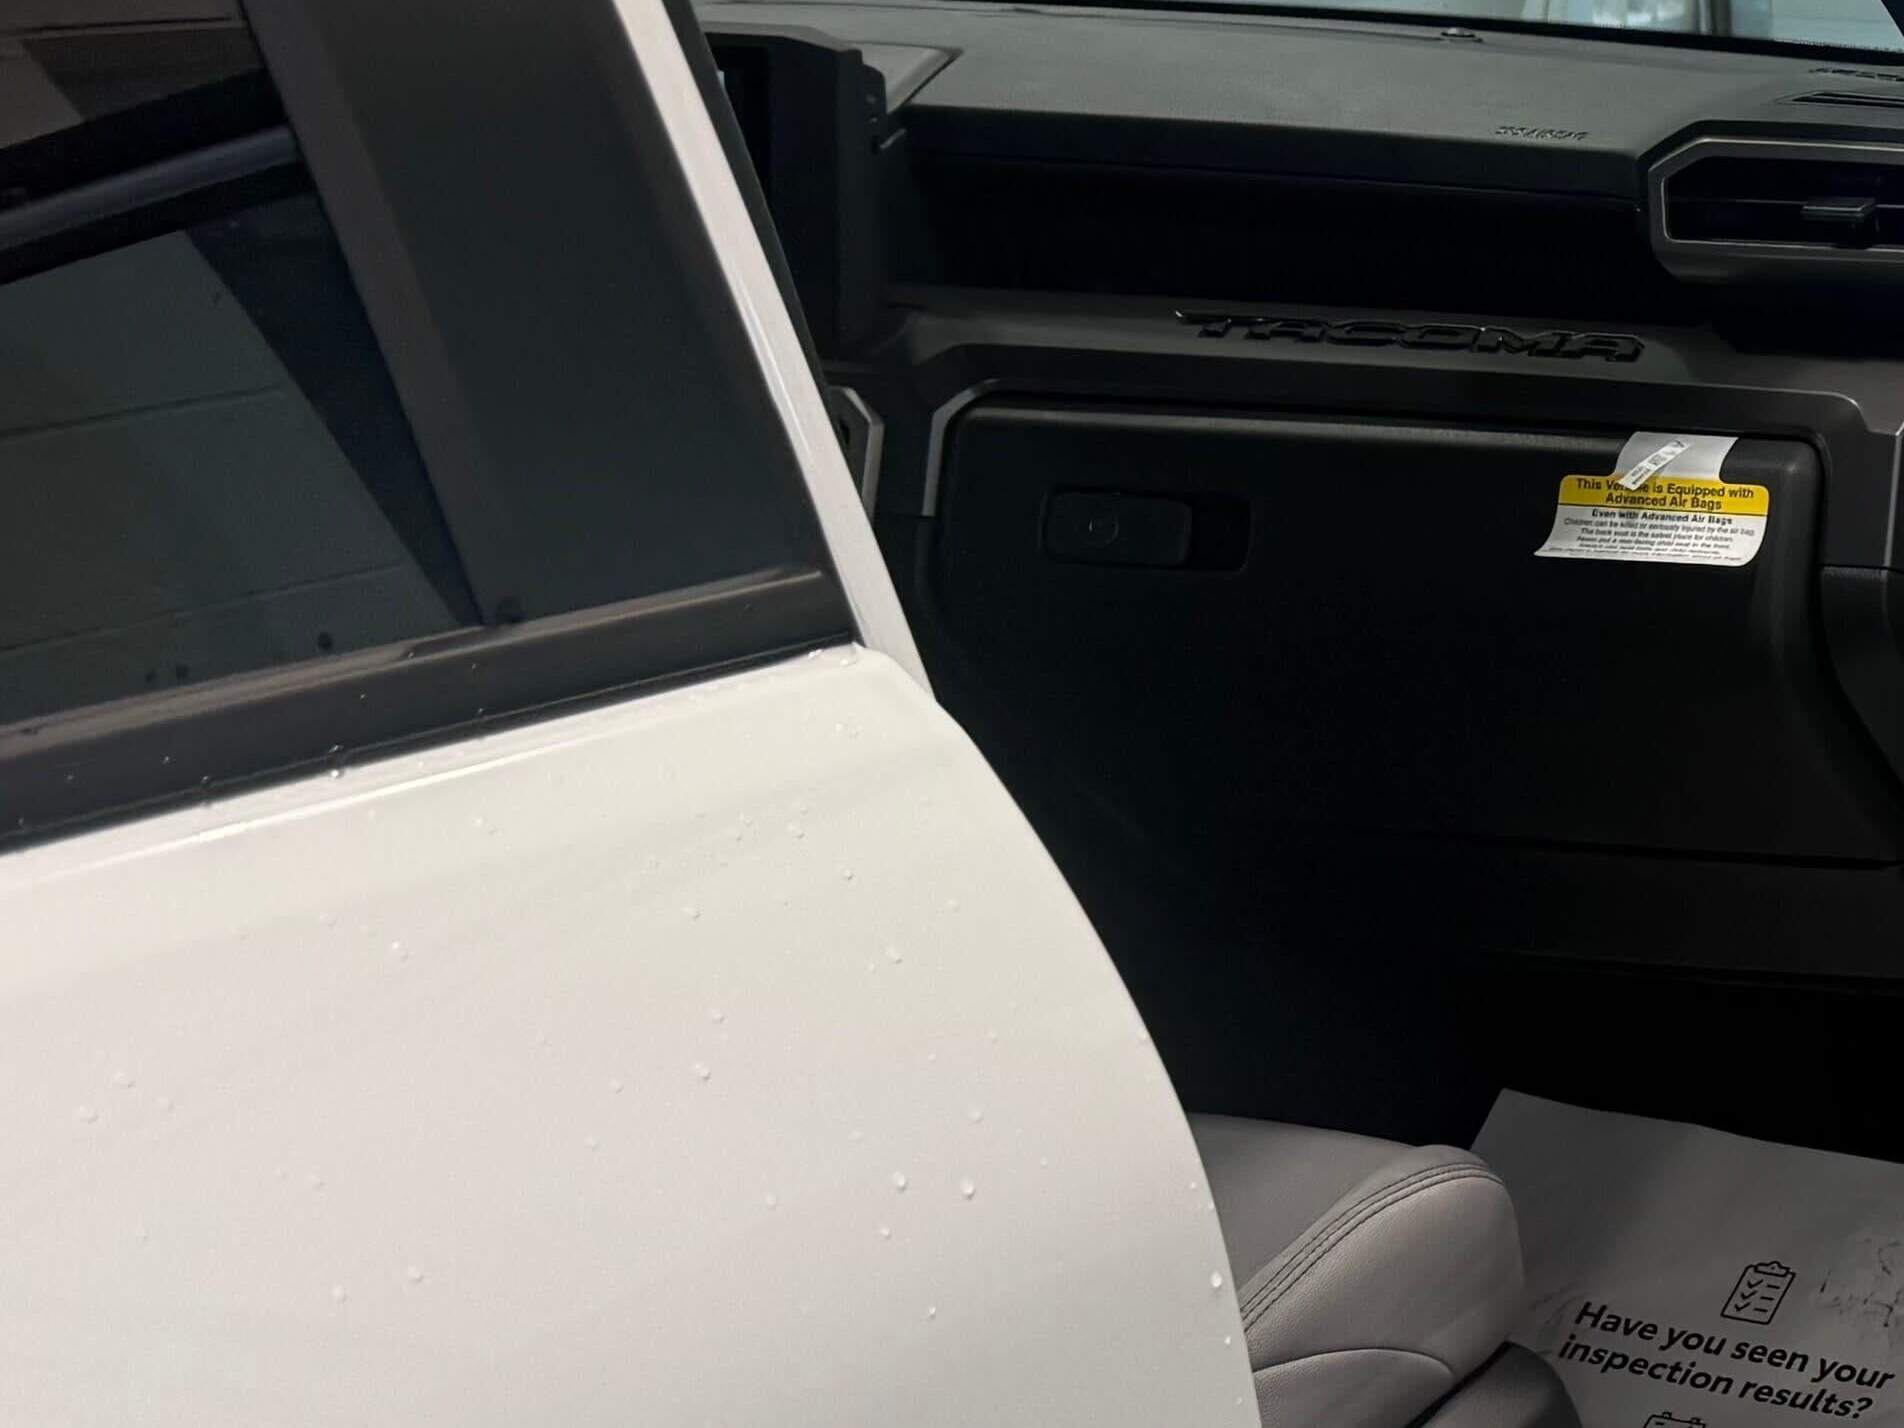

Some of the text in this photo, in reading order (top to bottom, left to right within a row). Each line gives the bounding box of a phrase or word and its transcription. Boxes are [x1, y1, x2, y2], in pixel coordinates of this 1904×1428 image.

[1175, 310, 1645, 363] TACOMA
[1576, 478, 1602, 490] This
[1652, 480, 1663, 493] is
[1667, 483, 1725, 498] Equipped
[1728, 487, 1754, 498] with
[1605, 492, 1722, 510] Advanced Air Bags
[1618, 510, 1639, 519] with
[1641, 512, 1689, 522] Advanced
[1691, 515, 1705, 523] Air
[1574, 1301, 1896, 1390] Have you seen your
[1556, 1334, 1874, 1421] inspection results?
